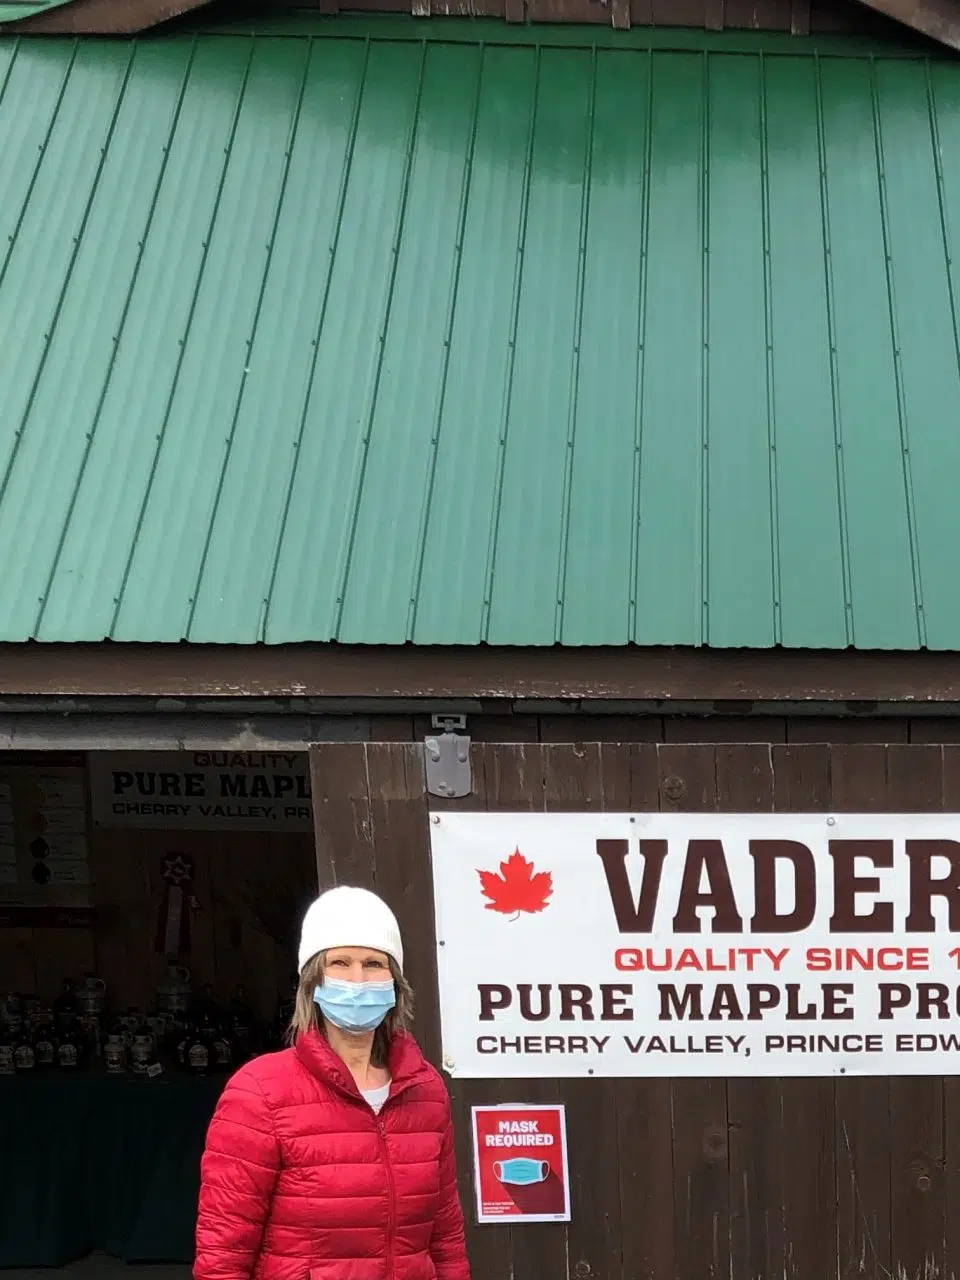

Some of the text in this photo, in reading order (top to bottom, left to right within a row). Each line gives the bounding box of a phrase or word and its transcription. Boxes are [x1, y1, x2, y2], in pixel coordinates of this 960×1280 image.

[194, 751, 298, 768] QUALITY
[112, 770, 312, 799] PURE MAPL
[112, 802, 191, 817] CHERRY
[198, 804, 277, 820] VALLEY,
[614, 948, 789, 972] QUALITY
[806, 947, 930, 971] SINCE
[477, 983, 634, 1022] PURE
[657, 982, 855, 1021] MAPLE
[476, 1035, 611, 1054] CHERRY
[624, 1035, 751, 1057] VALLEY,
[765, 1034, 884, 1053] PRINCE
[498, 1120, 540, 1133] MASK
[485, 1133, 554, 1148] REQUIRED
